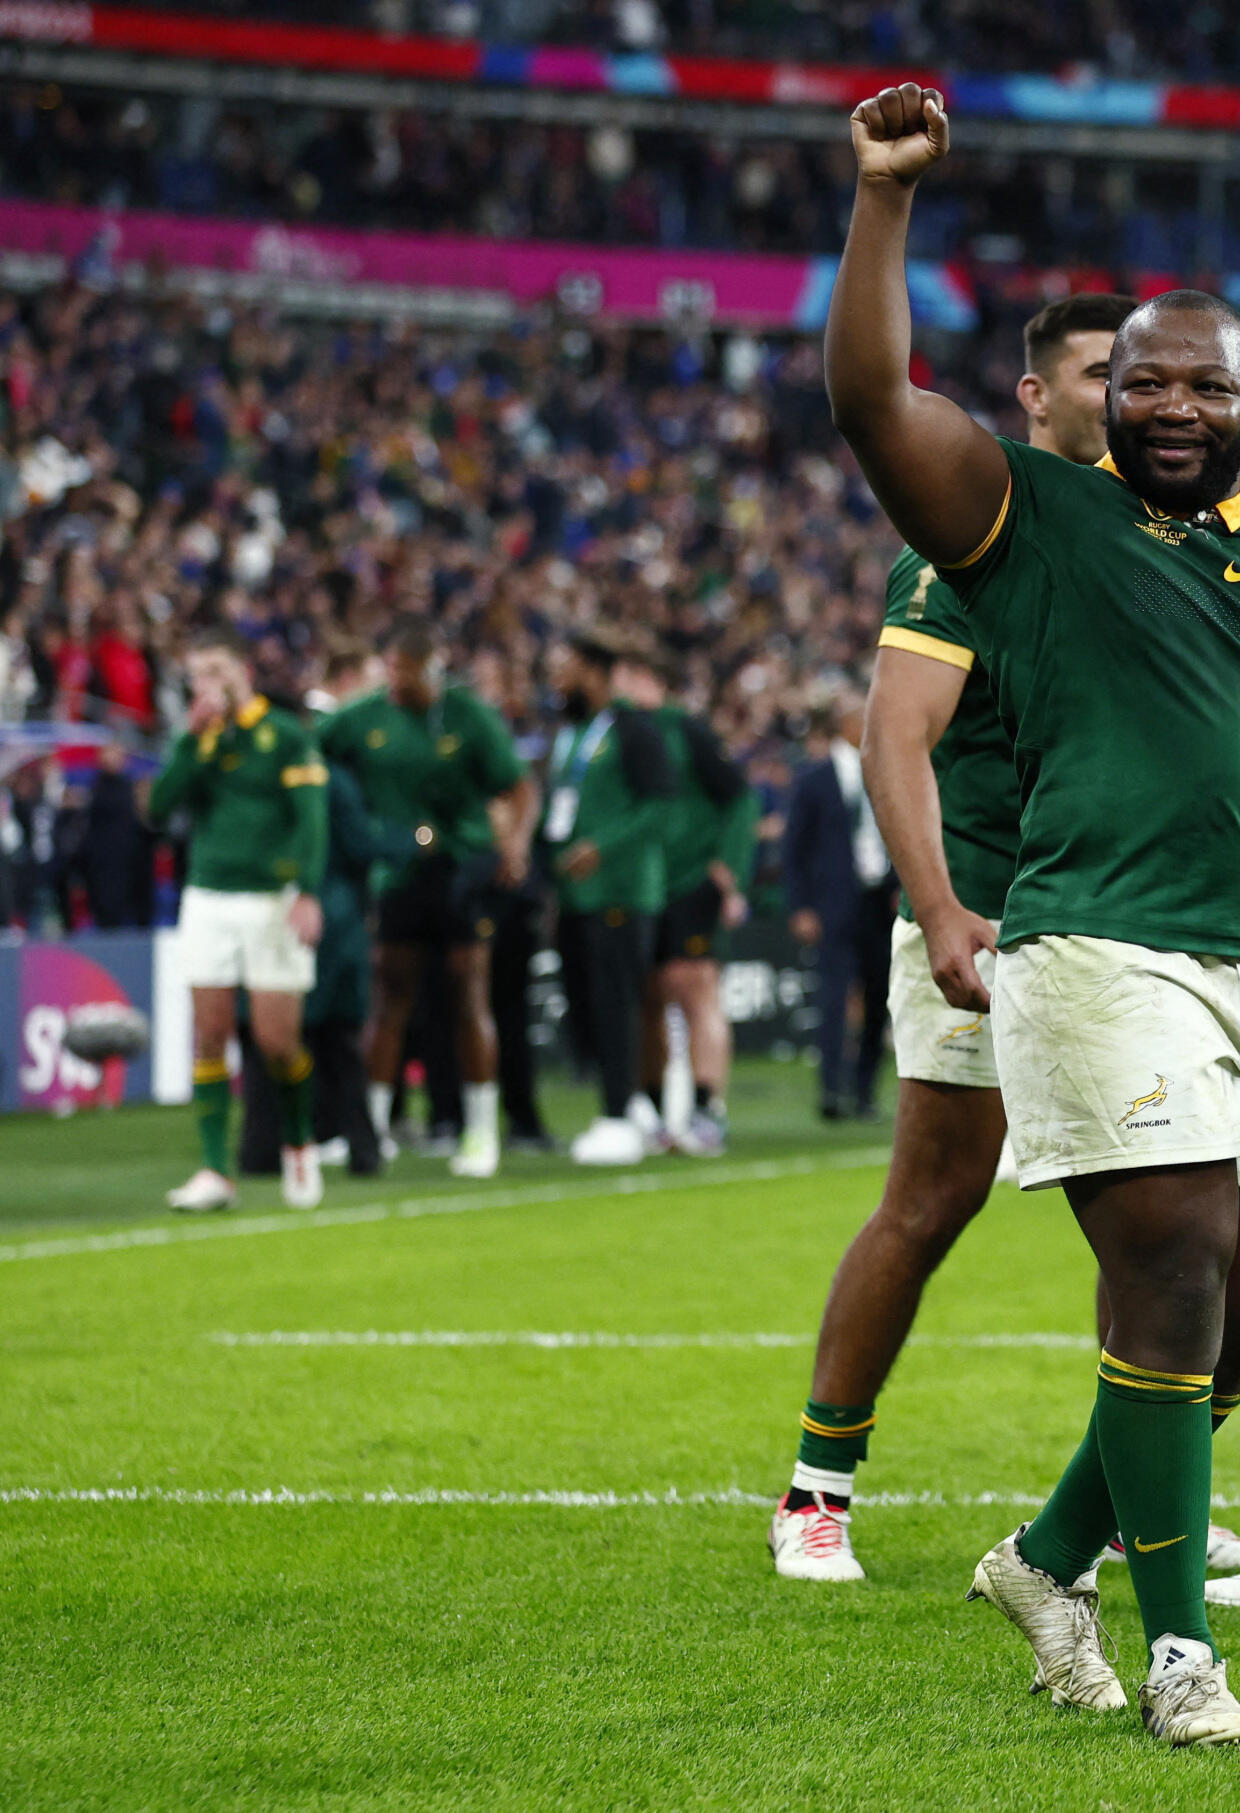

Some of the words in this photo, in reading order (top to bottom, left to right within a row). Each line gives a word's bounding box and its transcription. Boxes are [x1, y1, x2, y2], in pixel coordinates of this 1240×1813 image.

[1169, 531, 1187, 539] CUP
[1164, 538, 1180, 546] 2023
[1126, 1119, 1171, 1130] SPRINGBOK
